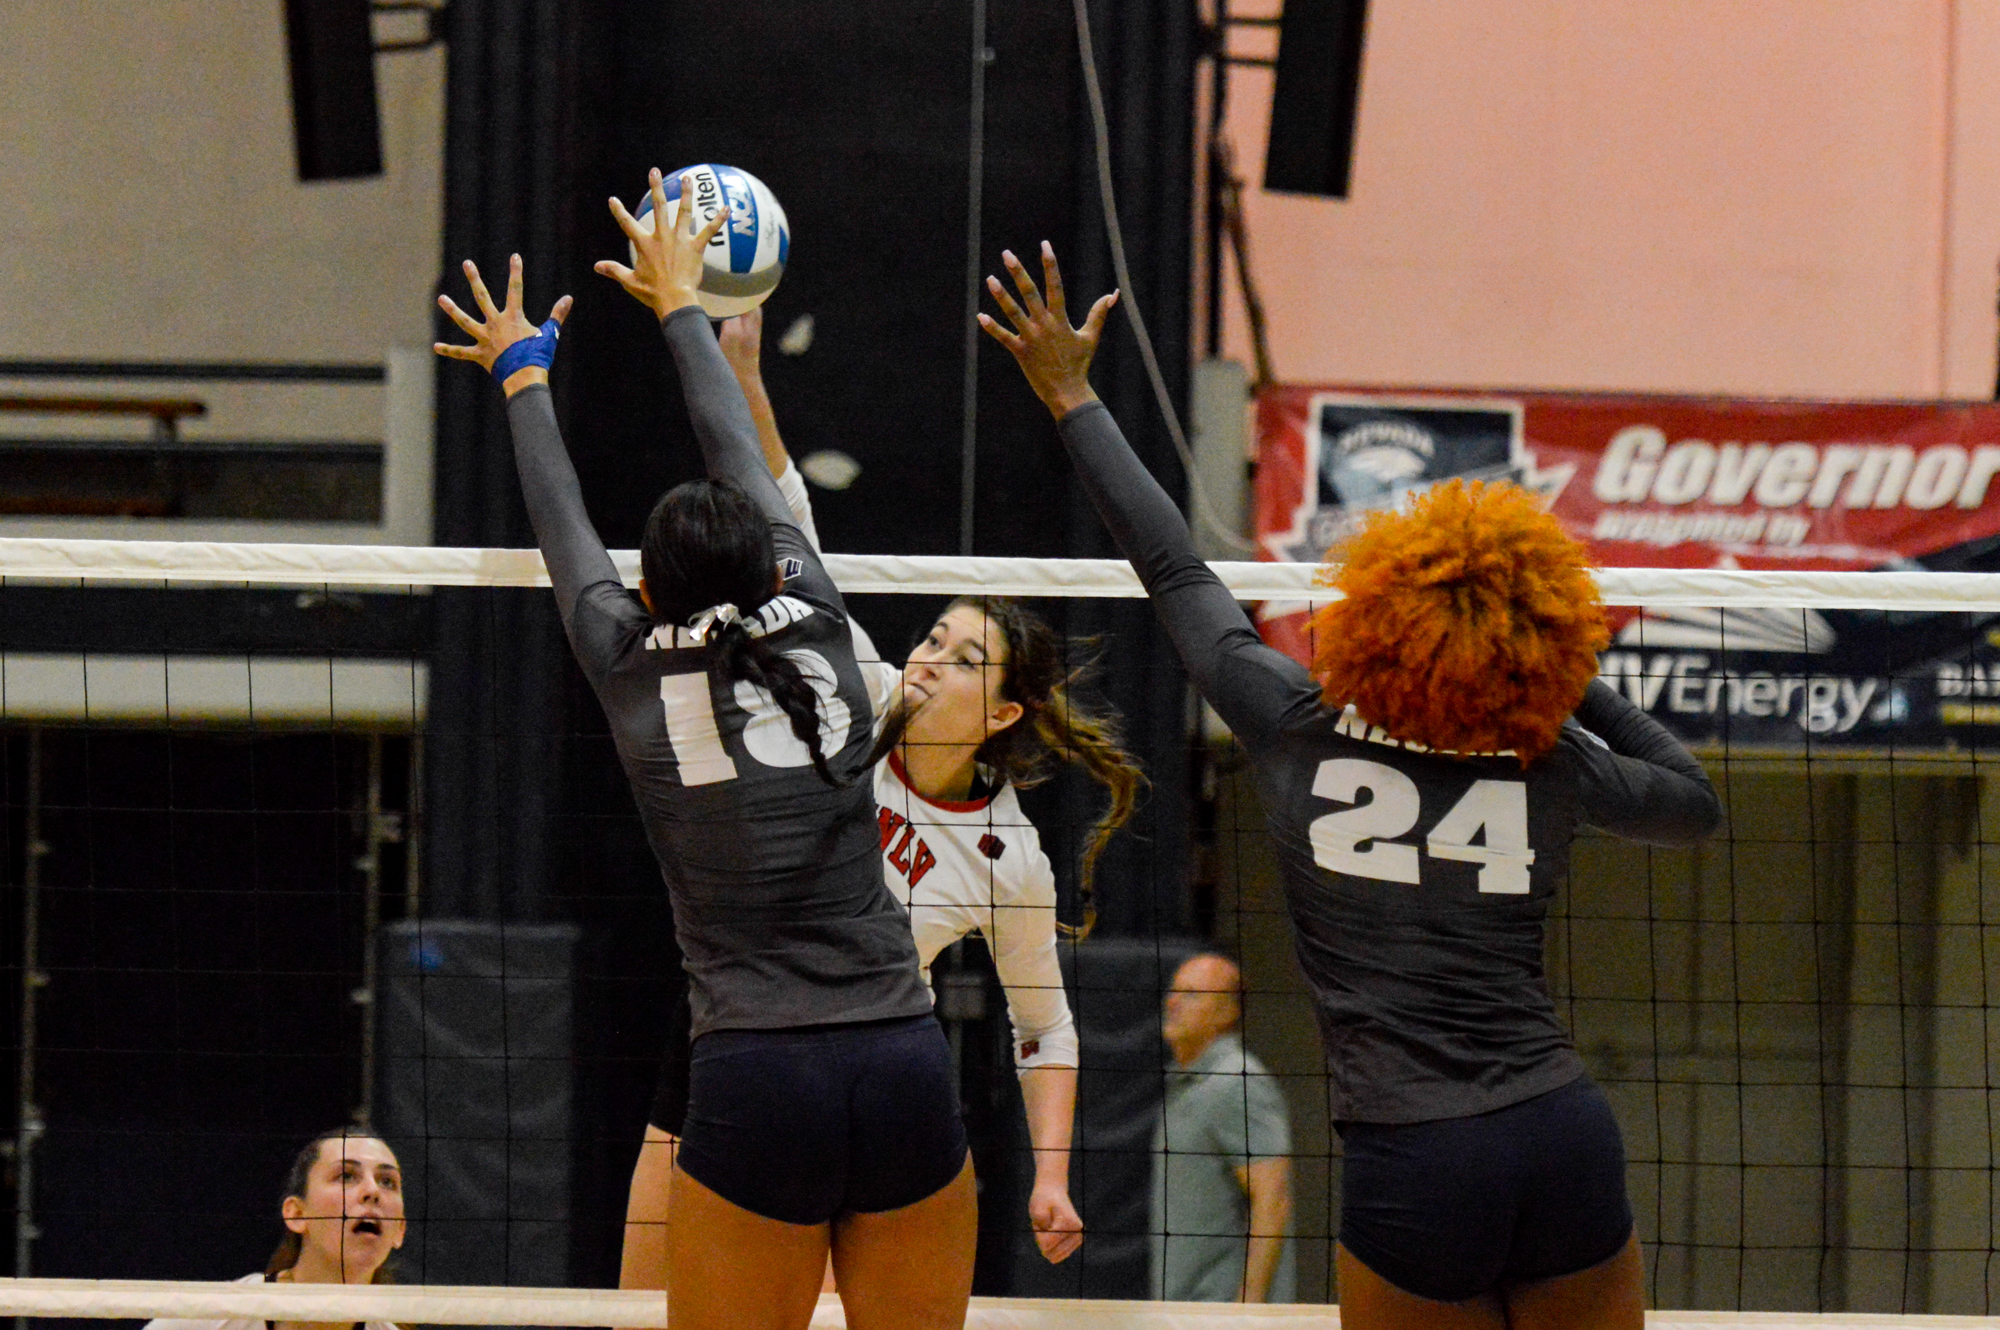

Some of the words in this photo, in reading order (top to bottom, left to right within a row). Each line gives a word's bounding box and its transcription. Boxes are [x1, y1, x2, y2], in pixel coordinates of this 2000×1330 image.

[1593, 423, 2000, 508] Governor
[645, 596, 815, 650] NEDA
[875, 804, 937, 890] NLV
[1309, 758, 1535, 895] 24
